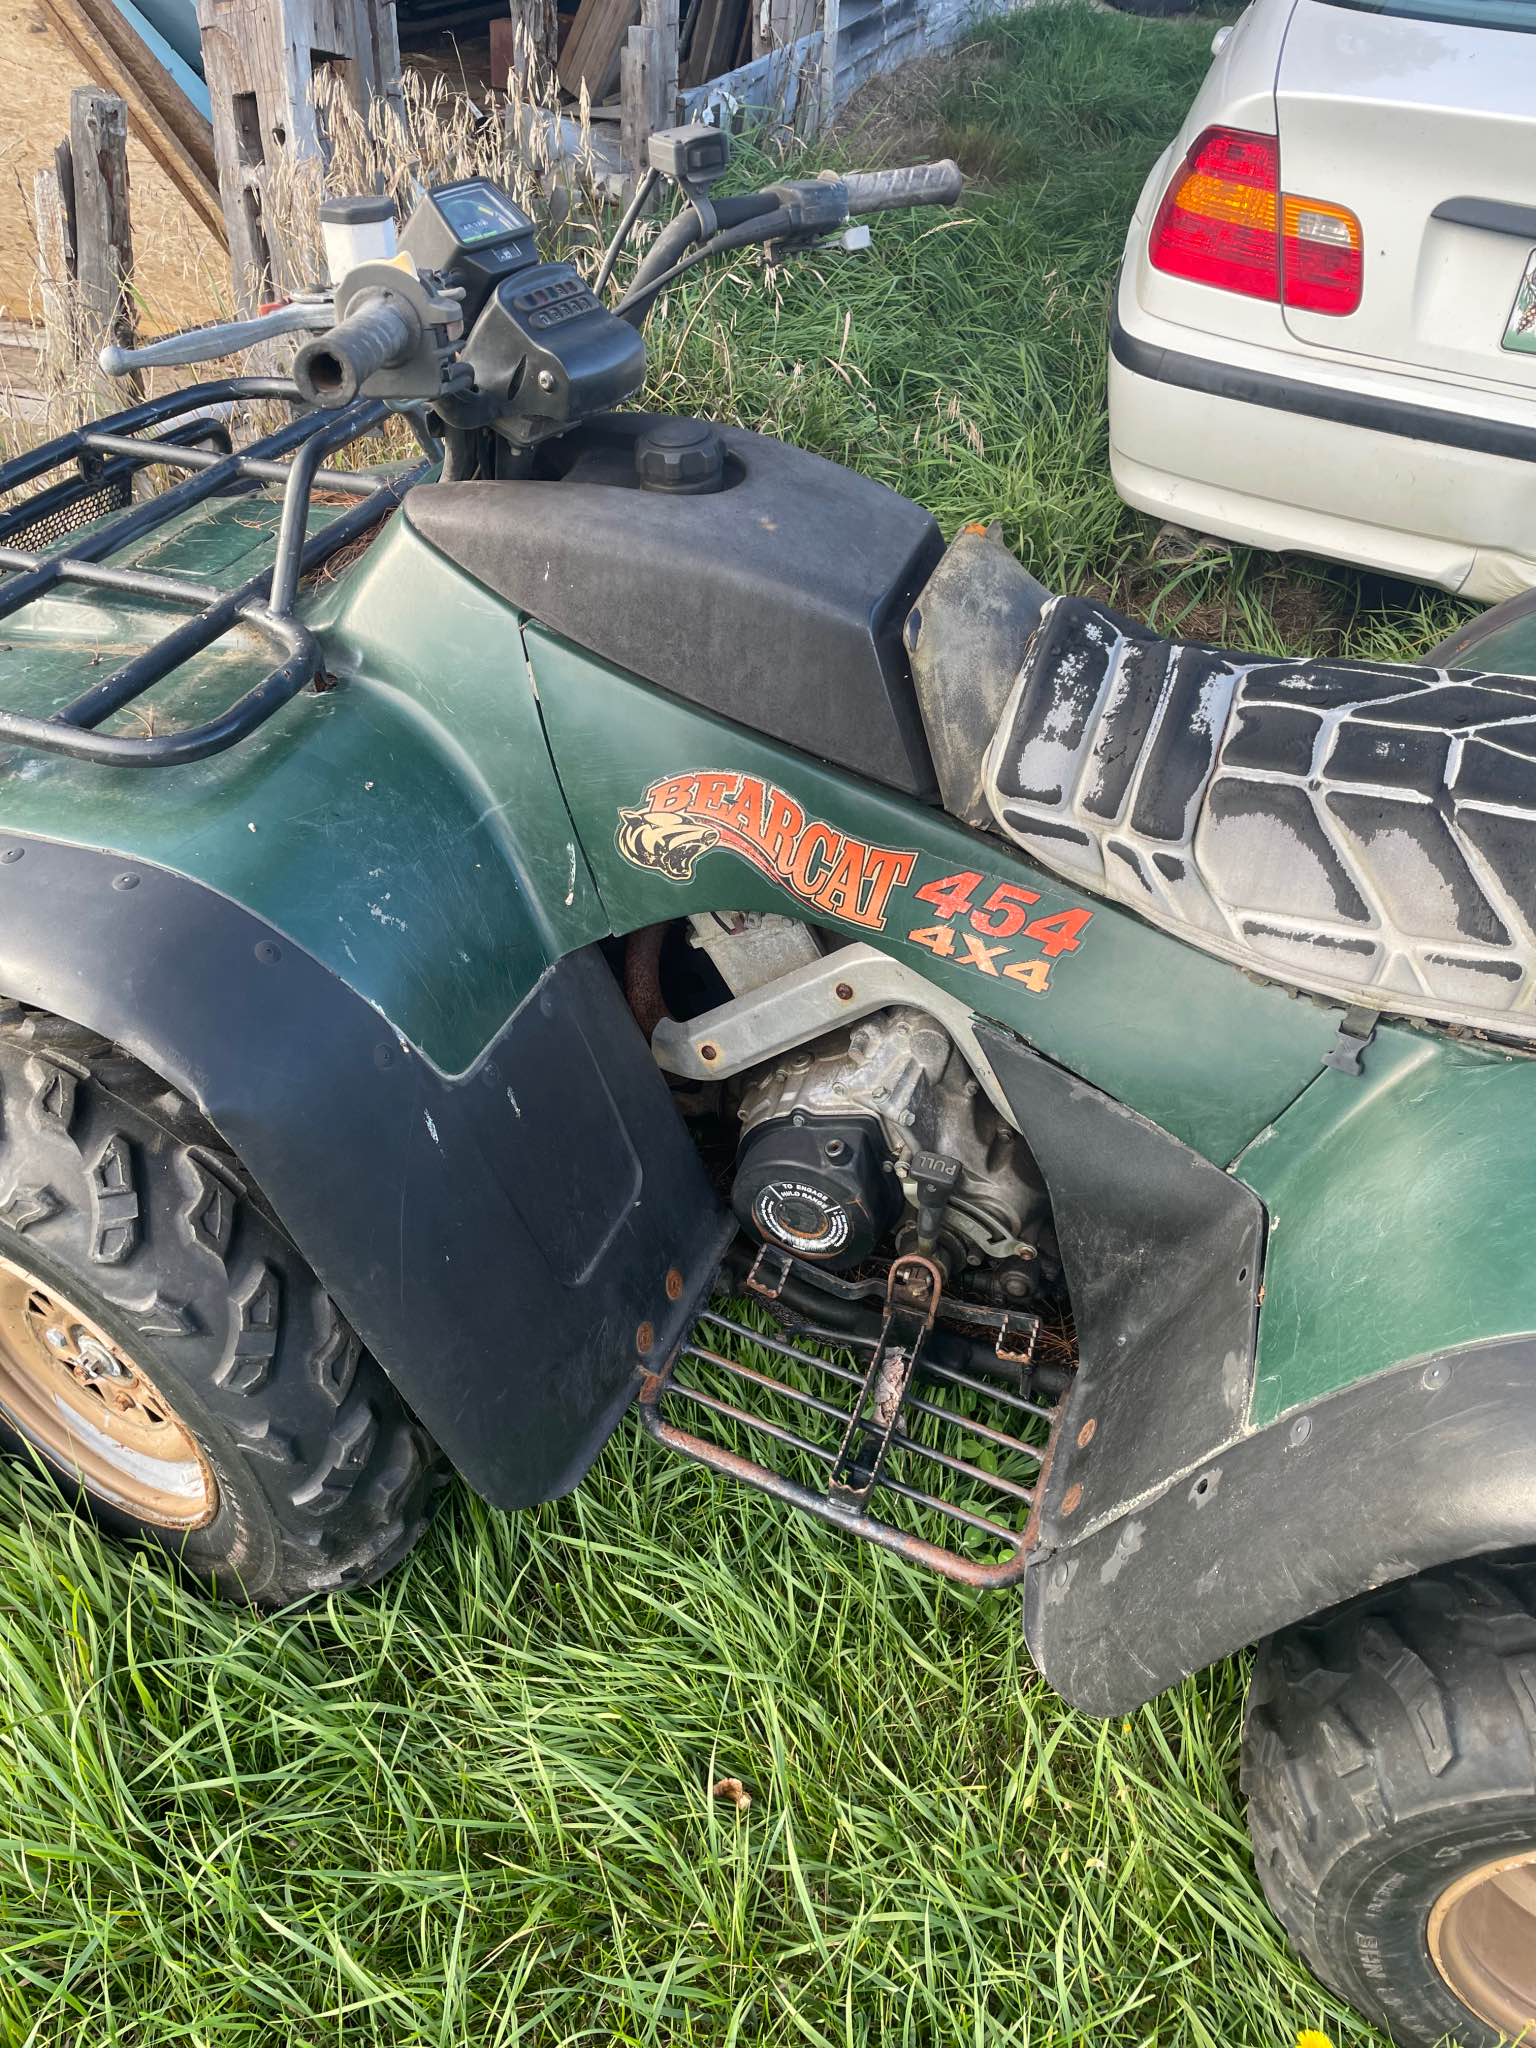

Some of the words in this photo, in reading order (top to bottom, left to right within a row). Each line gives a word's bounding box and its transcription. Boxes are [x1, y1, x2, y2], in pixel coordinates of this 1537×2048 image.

[647, 772, 919, 932] BEARCAT
[914, 870, 1095, 959] 454
[907, 924, 1053, 994] 4X4
[919, 1156, 957, 1176] PULL
[796, 1184, 829, 1201] ENGAGE
[801, 1192, 828, 1210] RANGE
